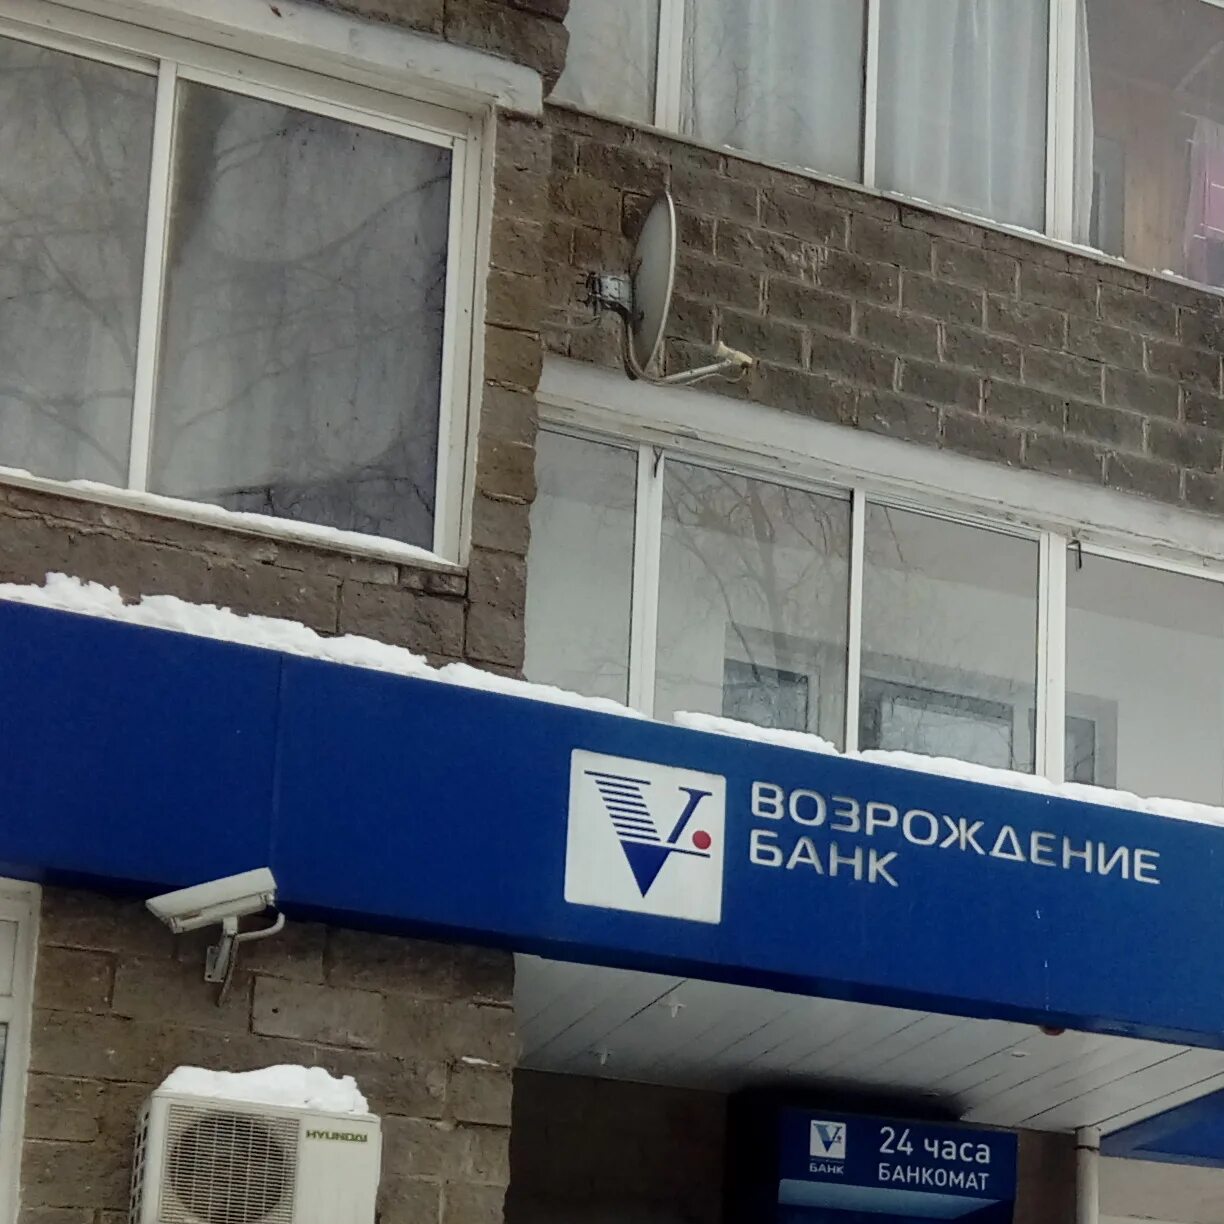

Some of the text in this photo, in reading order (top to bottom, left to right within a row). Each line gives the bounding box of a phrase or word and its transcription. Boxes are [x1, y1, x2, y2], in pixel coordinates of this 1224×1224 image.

[750, 781, 1161, 885] ВОЗРОЖДЕНИЕ
[749, 830, 899, 886] БАНК
[306, 1129, 367, 1142] HYUNDAI
[879, 1126, 991, 1164] 24 часа
[809, 1162, 844, 1175] БАНК
[878, 1162, 990, 1191] БАНКОМАТ
